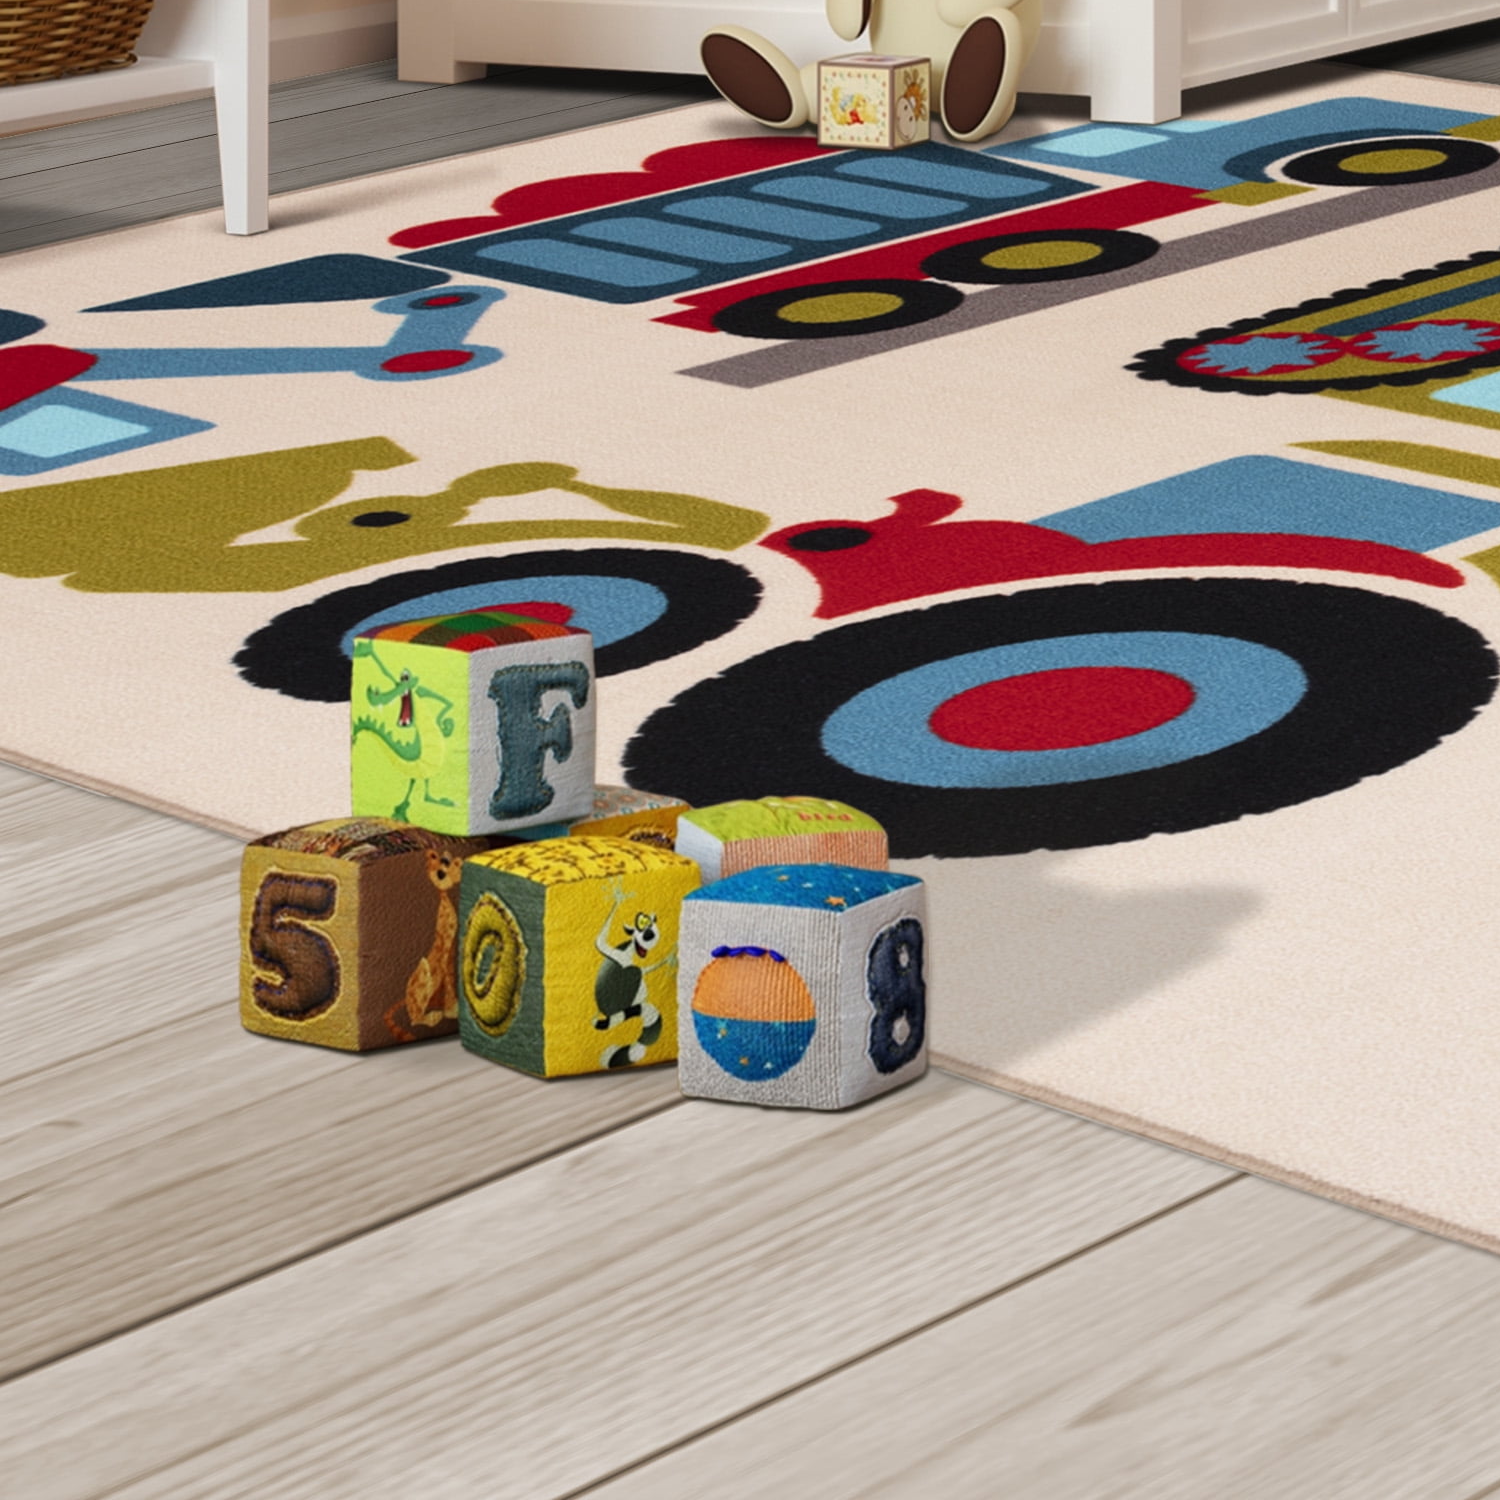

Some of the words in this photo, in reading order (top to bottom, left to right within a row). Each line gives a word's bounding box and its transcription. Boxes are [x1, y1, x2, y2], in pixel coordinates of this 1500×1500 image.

[488, 660, 590, 820] F
[249, 870, 343, 1023] 5
[867, 916, 927, 1076] 8
